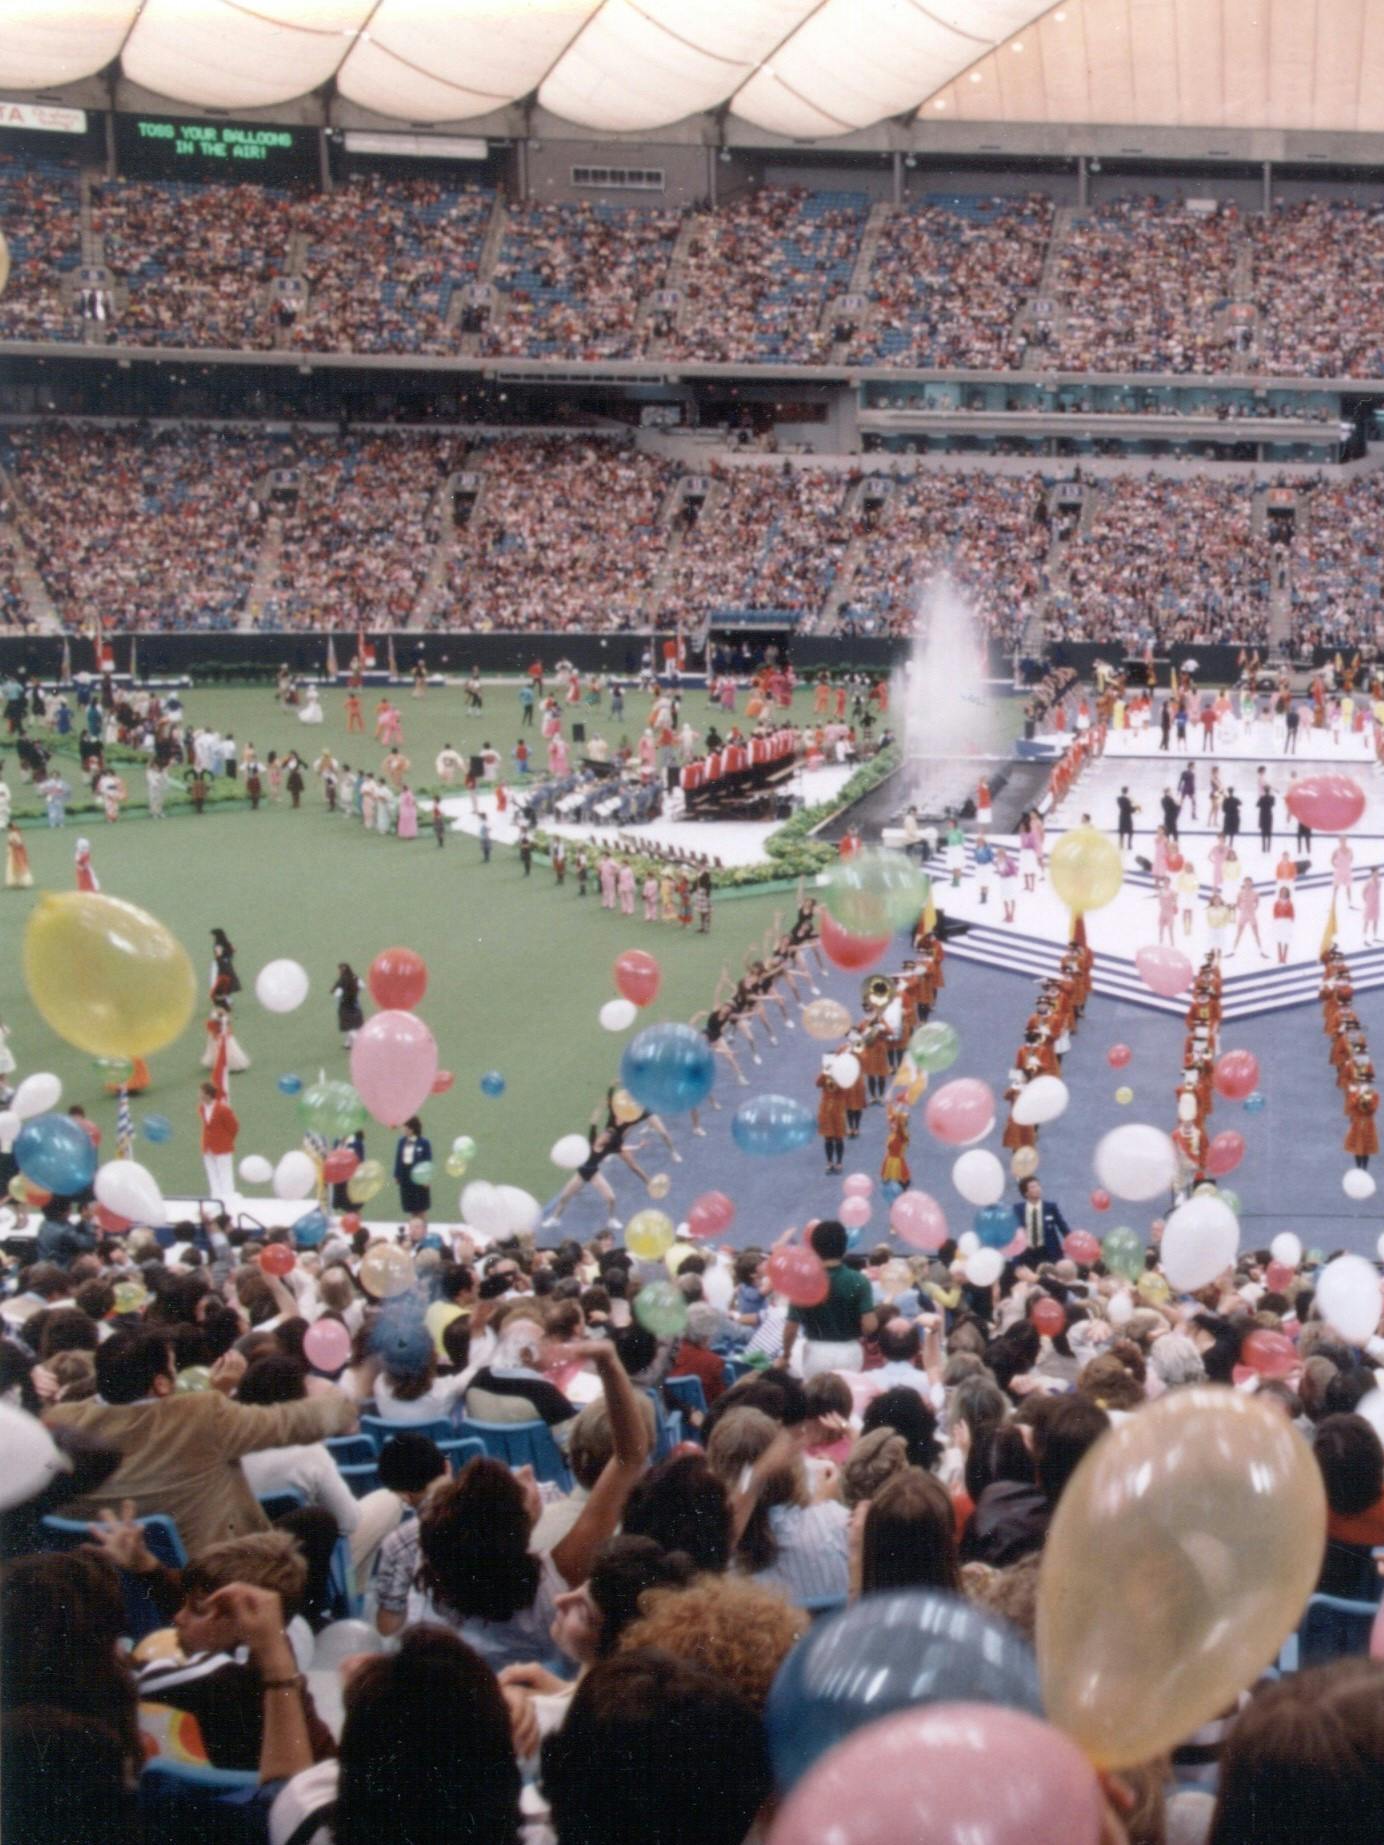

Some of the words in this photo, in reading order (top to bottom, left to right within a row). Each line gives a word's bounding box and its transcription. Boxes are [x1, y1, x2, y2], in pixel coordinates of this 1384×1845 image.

[138, 122, 175, 139] TOSS
[180, 126, 217, 142] YOUR
[222, 128, 292, 147] BALLOONS
[176, 140, 194, 154] IN
[200, 141, 227, 157] THE
[233, 144, 266, 159] AIR!
